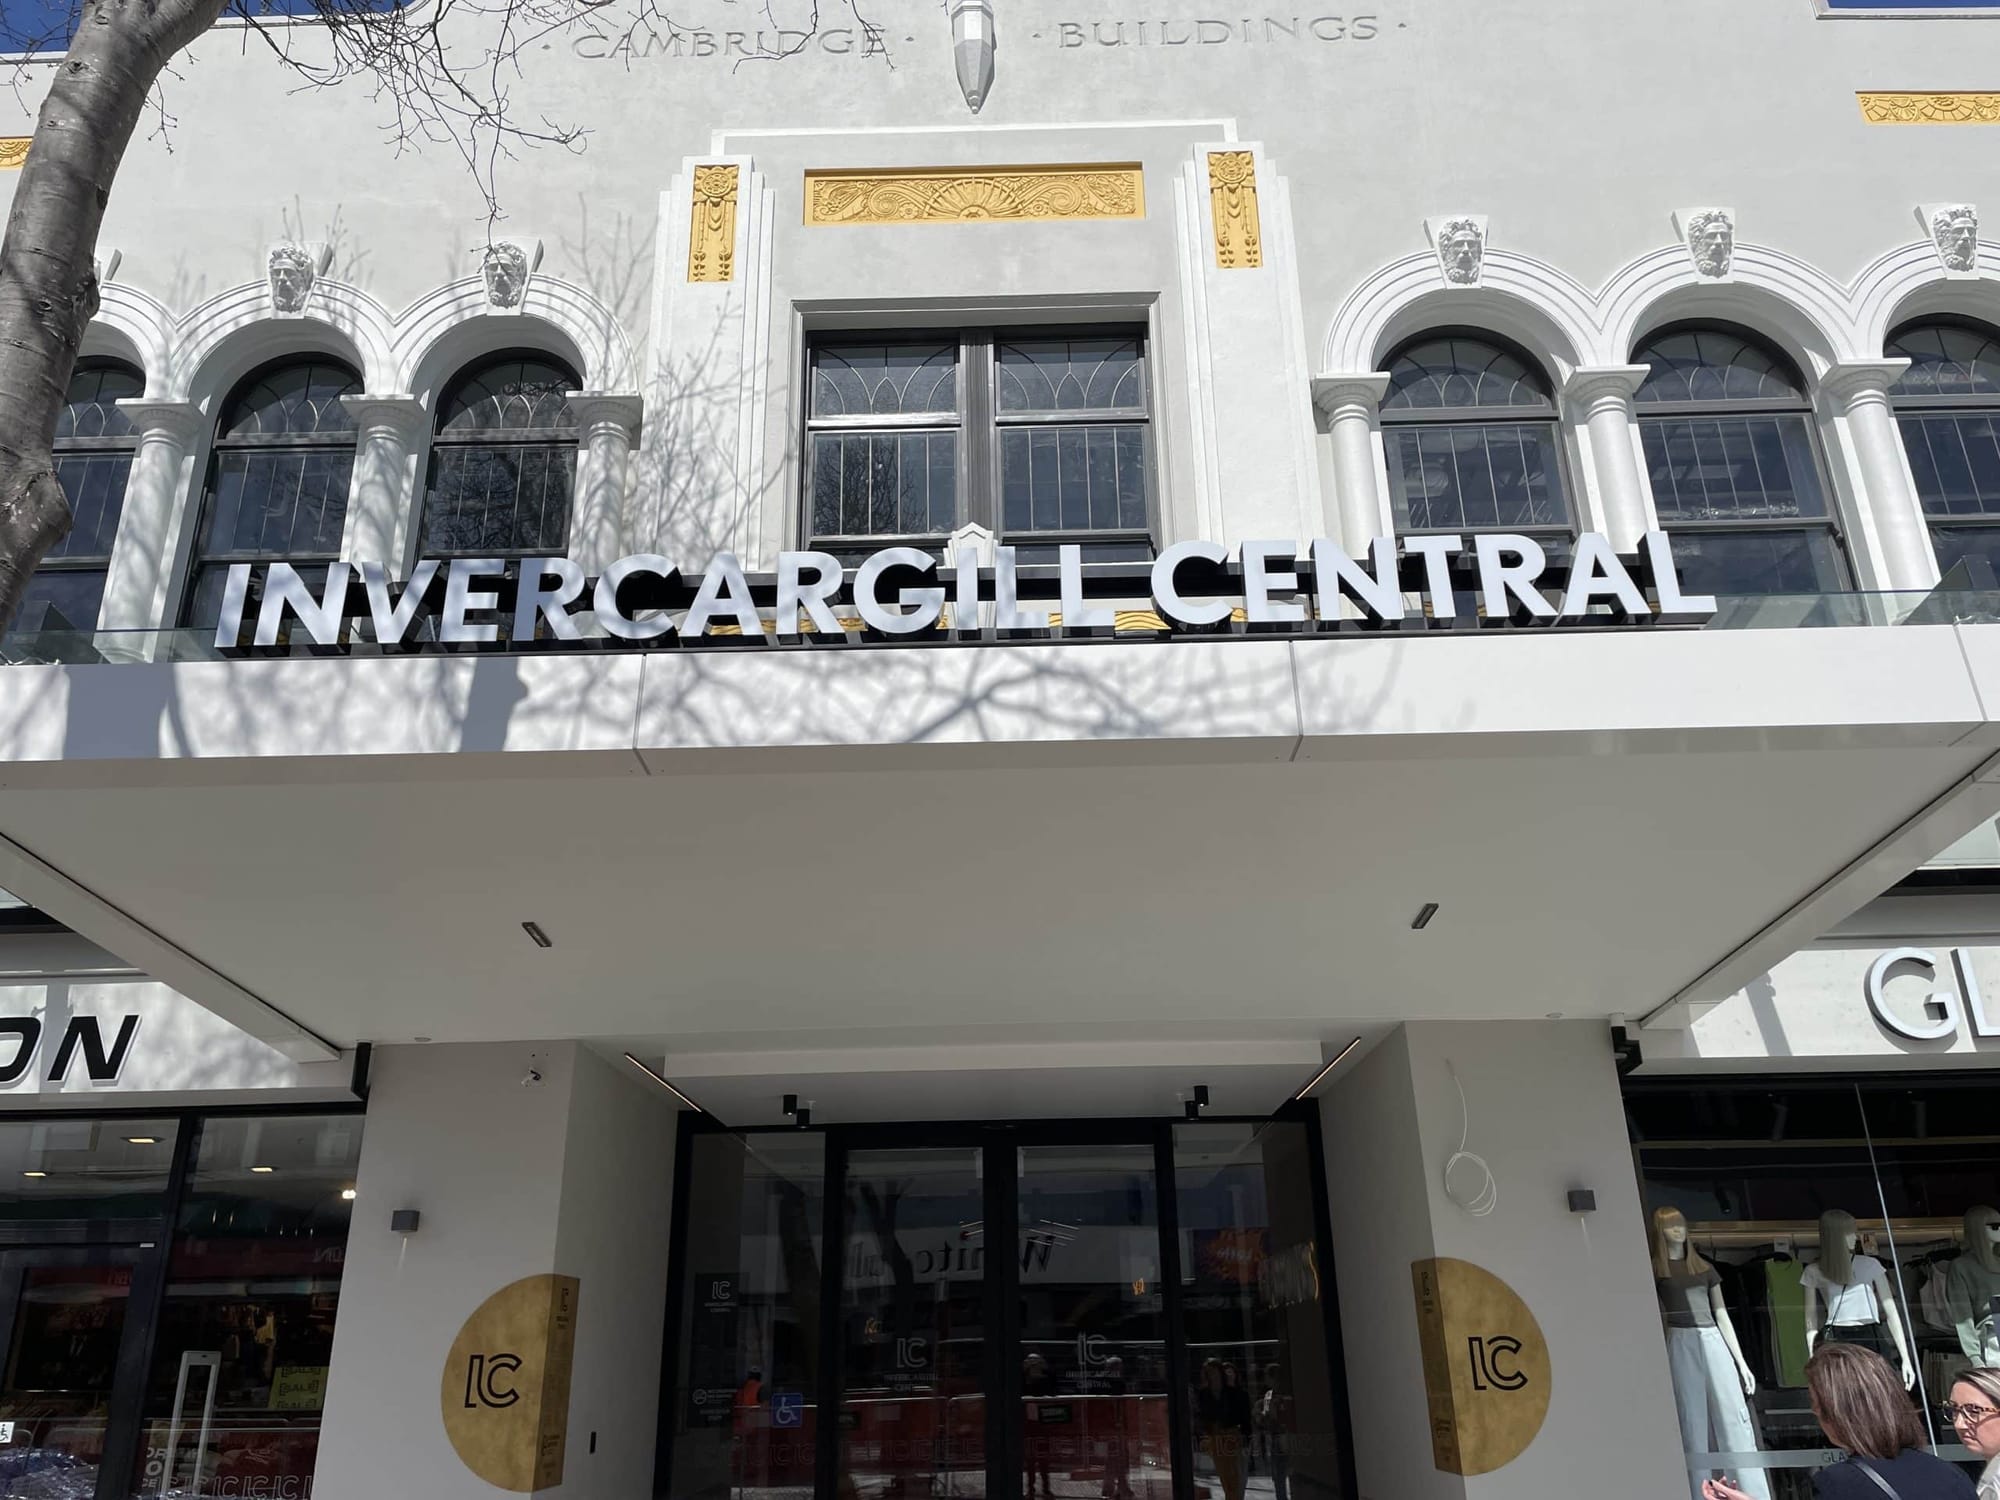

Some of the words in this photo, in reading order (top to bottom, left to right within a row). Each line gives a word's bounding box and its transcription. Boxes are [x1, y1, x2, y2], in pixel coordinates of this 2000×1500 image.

[571, 28, 893, 59] CAMBRIDGE
[1057, 15, 1379, 49] BUILDINGS
[213, 545, 1116, 650] INVERCARGILL
[1150, 530, 1718, 627] CENTRAL
[463, 1352, 523, 1409] IC
[1467, 1335, 1529, 1392] IC
